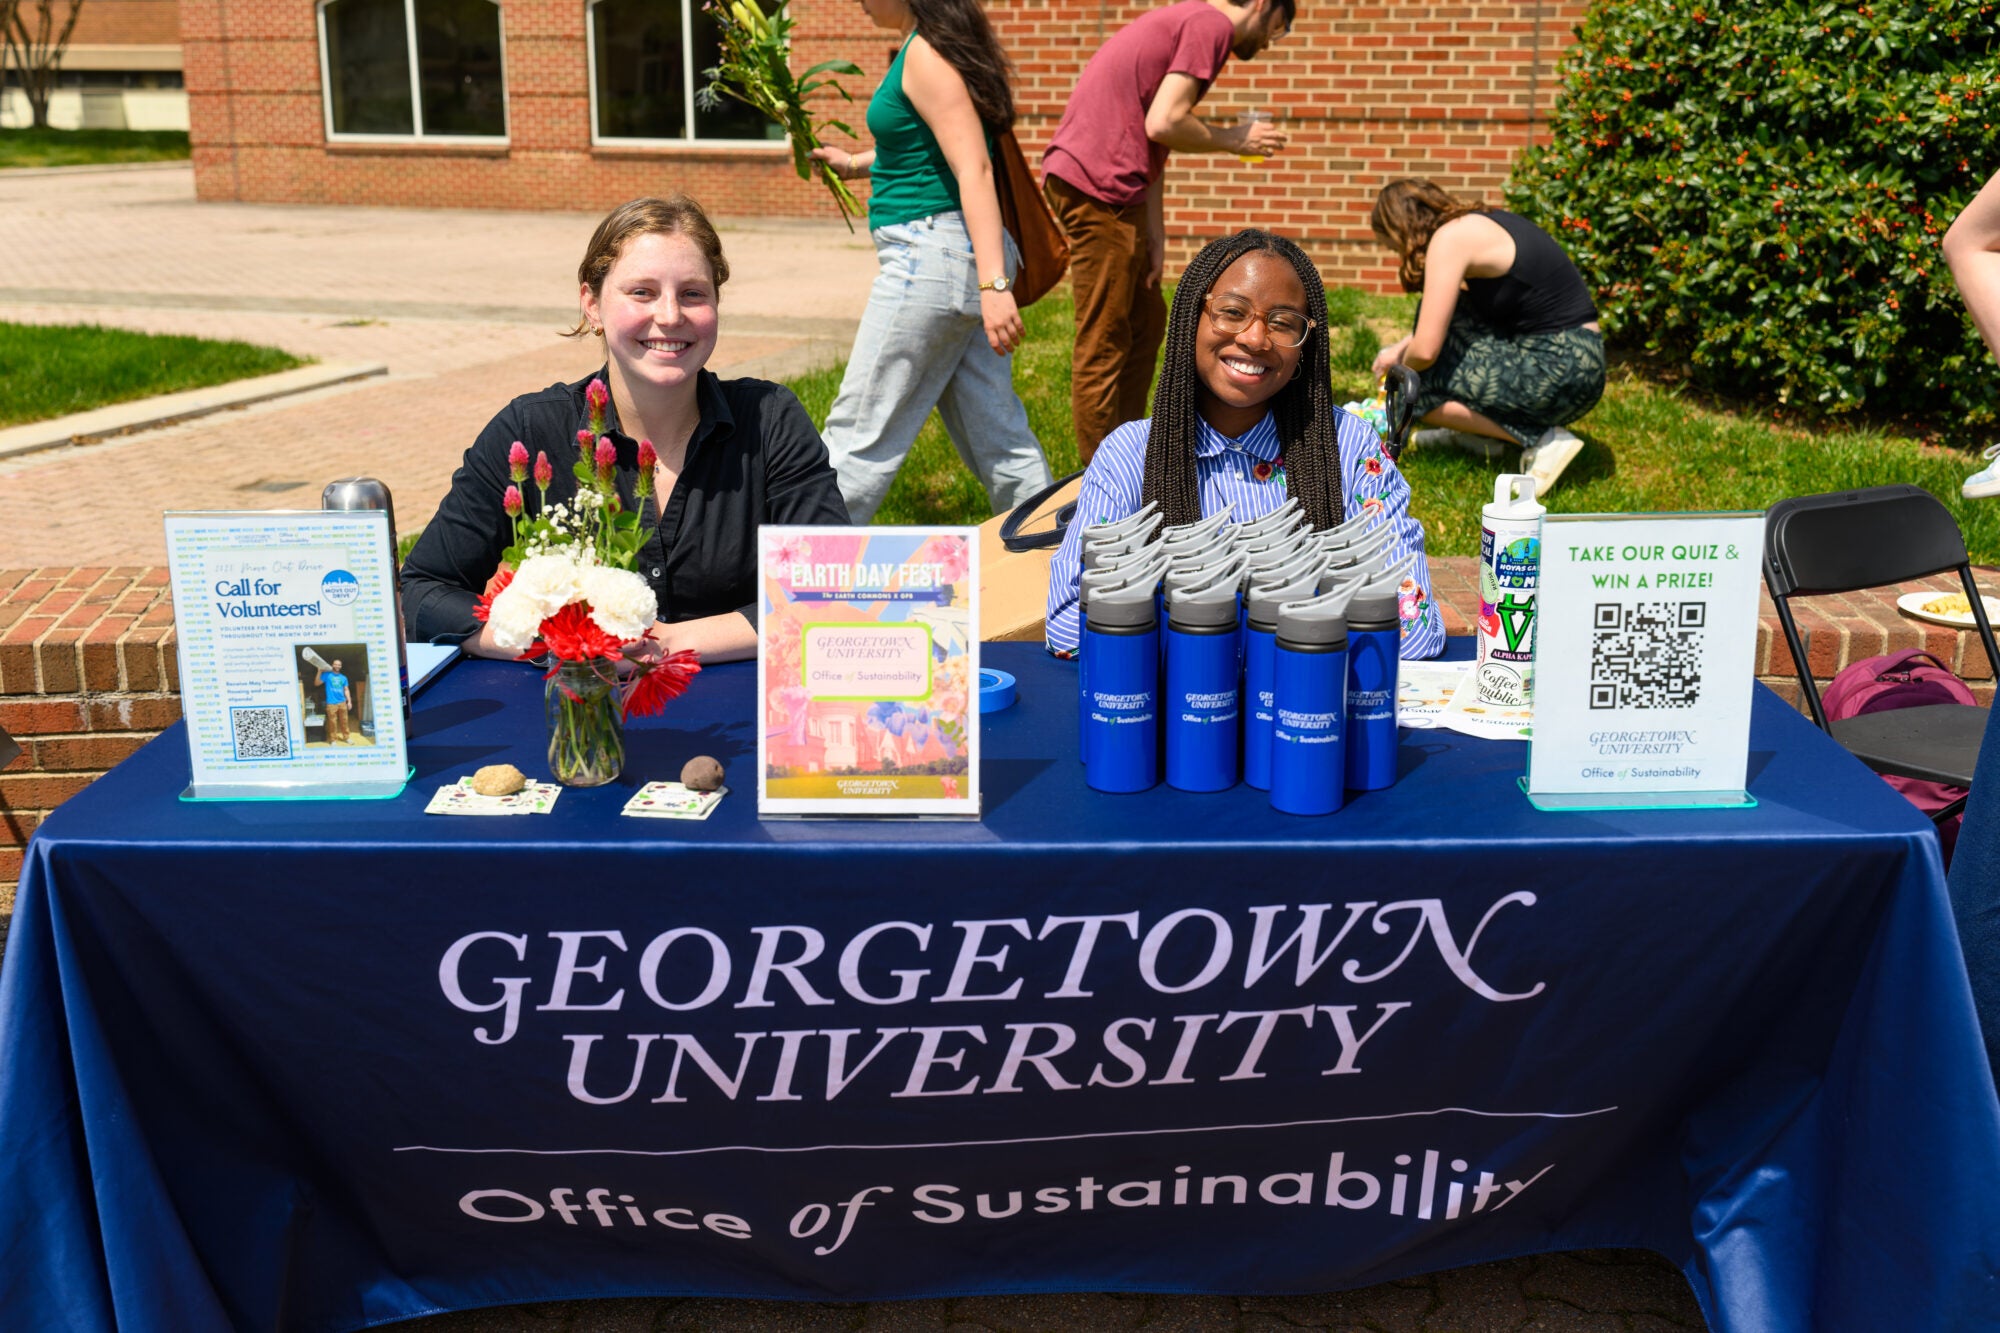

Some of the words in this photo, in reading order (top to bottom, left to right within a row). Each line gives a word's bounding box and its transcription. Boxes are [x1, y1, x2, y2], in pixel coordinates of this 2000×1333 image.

[1568, 546, 1615, 562] TAKE
[1622, 545, 1665, 561] OUR
[1671, 545, 1719, 561] QUIZ
[1725, 544, 1739, 560] &
[1500, 563, 1526, 572] HOYAS
[790, 563, 851, 588] EARTH
[855, 563, 893, 588] DAY
[899, 563, 944, 588] FEST
[1591, 574, 1630, 589] WIN
[1636, 574, 1649, 589] A
[1656, 572, 1714, 588] PRIZE!
[215, 578, 251, 597] Call
[254, 578, 282, 596] for
[216, 600, 322, 618] Volunteers!
[817, 636, 916, 650] GEORGETOWN
[826, 648, 904, 659] UNIVERSITY
[1492, 650, 1516, 660] ALPHA
[812, 671, 843, 681] Office
[845, 671, 855, 683] of
[857, 670, 922, 683] Sustainability
[1483, 669, 1518, 690] Coffee
[1093, 691, 1151, 702] GEORGETOWN
[1477, 680, 1519, 707] epublic
[1098, 700, 1146, 710] UNIVERSITY
[1091, 712, 1109, 723] Office
[1181, 713, 1202, 723] Office
[1278, 708, 1338, 722] GEORGETOWN
[1355, 711, 1393, 721] Sustainability
[1281, 717, 1331, 729] UNIVERSITY
[1275, 729, 1291, 742] Office
[1299, 734, 1340, 744] Sustainability
[1589, 730, 1697, 747] GEORGETOWN
[1599, 743, 1684, 755] UNIVERSITY
[1581, 767, 1615, 778] Office
[1617, 767, 1629, 781] of
[1631, 766, 1702, 779] Sustainability
[836, 779, 900, 790] GEORGETOWN
[842, 787, 892, 795] UNIVERSITY
[438, 889, 1547, 1046] GEORGETOWN
[561, 1001, 1412, 1105] UNIVERSITY
[458, 1187, 753, 1240] Office
[789, 1185, 895, 1256] of
[911, 1148, 1556, 1224] Sustainability
